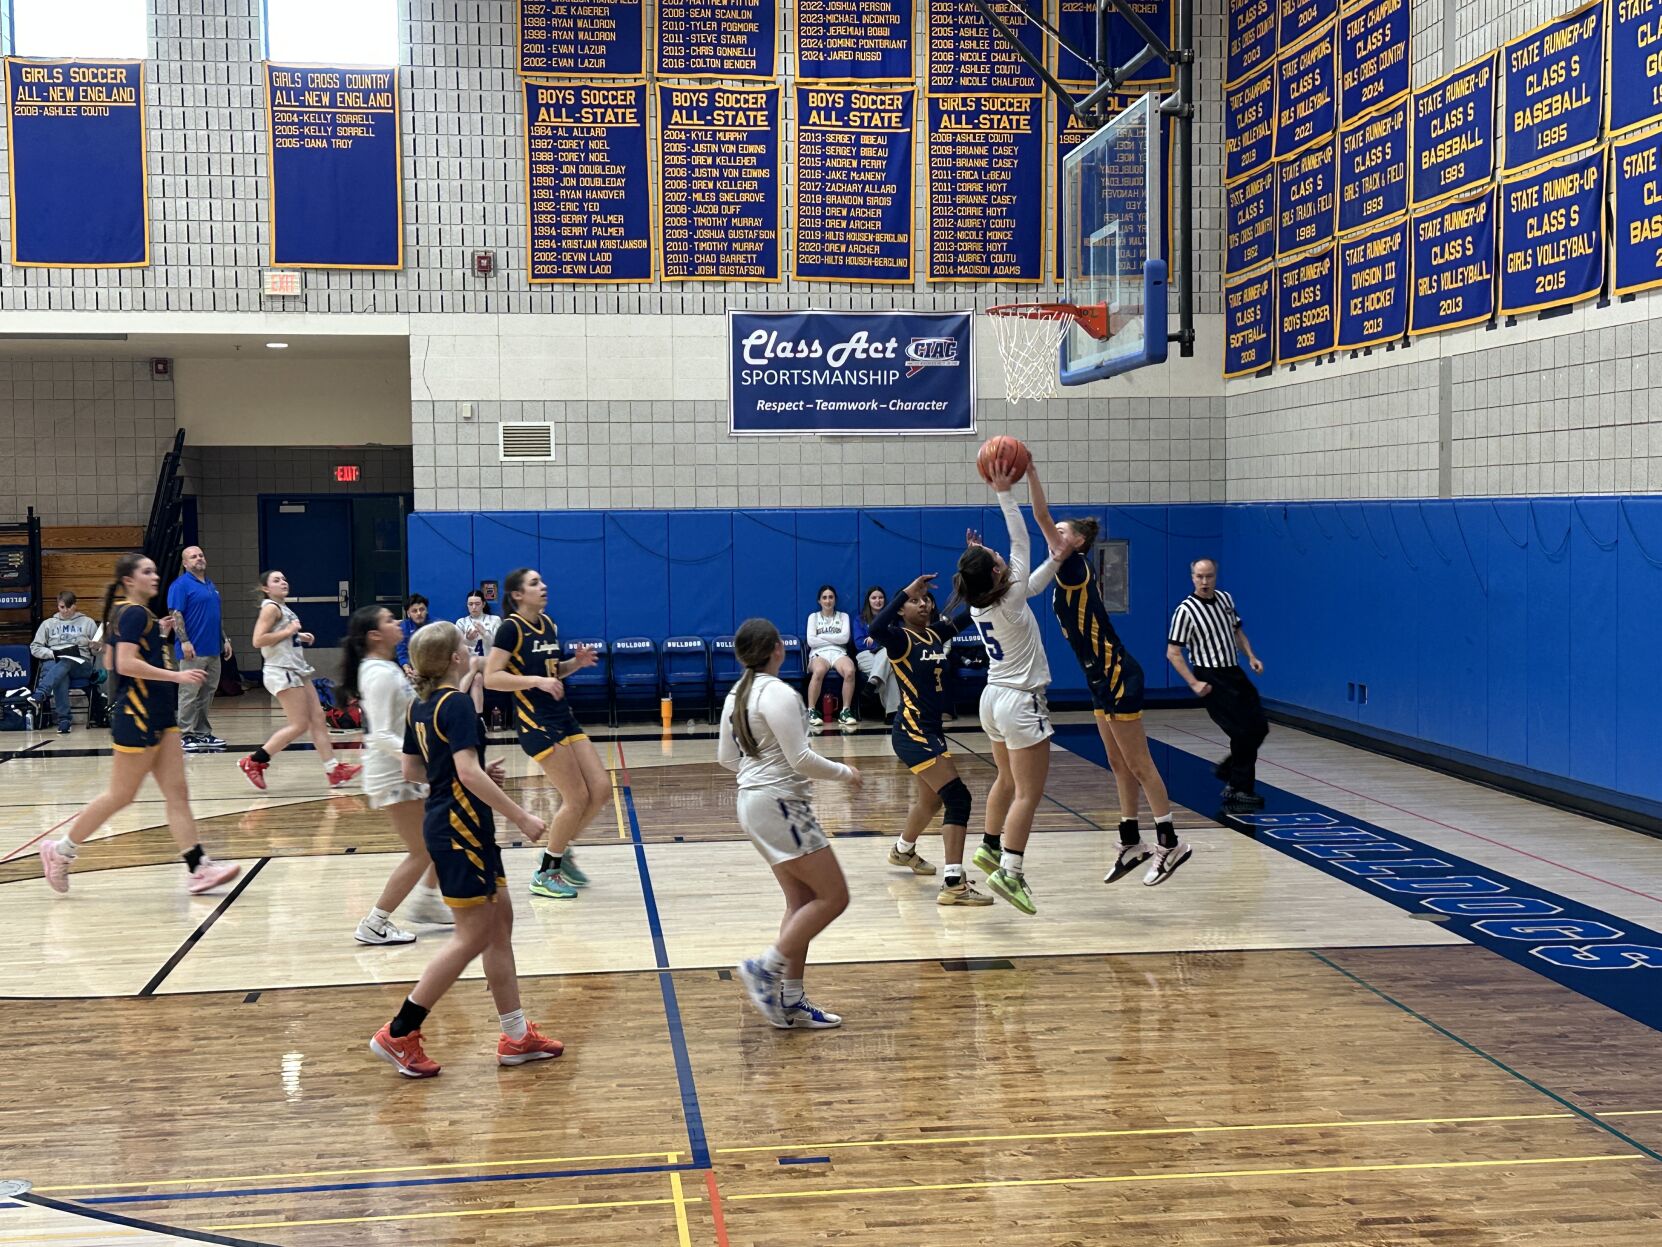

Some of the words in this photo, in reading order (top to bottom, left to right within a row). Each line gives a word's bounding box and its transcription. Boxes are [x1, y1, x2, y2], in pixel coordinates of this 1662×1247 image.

[860, 2, 891, 12] PERSON
[1347, 15, 1366, 40] STATE
[721, 35, 747, 44] STARR
[1356, 28, 1383, 59] CLASS
[1385, 23, 1391, 41] S
[1512, 41, 1540, 72] STATE
[1544, 15, 1596, 57] RUNNER-UP
[578, 45, 606, 54] LAZUR
[856, 52, 881, 60] RUSSO
[579, 59, 605, 68] LAZUR
[995, 65, 1020, 74] COUTU
[22, 68, 63, 82] GIRLS
[70, 68, 126, 83] SOCCER
[273, 72, 301, 87] GIRLS
[308, 74, 339, 88] CROSS
[346, 74, 390, 88] COUNTRY
[992, 77, 1034, 86] CHALIFOUX
[1290, 73, 1312, 99] CLASS
[1315, 69, 1320, 85] S
[1526, 61, 1566, 96] CLASS
[1571, 55, 1580, 77] S
[18, 86, 74, 101] ALL-NEW
[80, 87, 135, 101] ENGLAND
[275, 91, 329, 106] ALL-NEW
[337, 92, 392, 107] ENGLAND
[538, 89, 574, 104] BOYS
[582, 90, 635, 105] SOCCER
[1362, 79, 1384, 102] 2024
[1419, 90, 1442, 117] STATE
[1446, 67, 1489, 104] RUNNER-UP
[673, 92, 708, 106] BOYS
[715, 93, 766, 108] SOCCER
[809, 93, 844, 107] BOYS
[852, 94, 902, 109] SOCCER
[939, 98, 976, 111] GIRLS
[981, 98, 1030, 111] SOCCER
[1515, 83, 1591, 132] BASEBALL
[81, 107, 109, 116] COUTU
[336, 115, 374, 124] SORRELL
[538, 107, 637, 123] ALL-STATE
[671, 110, 768, 125] ALL-STATE
[809, 110, 902, 127] ALL-STATE
[1431, 107, 1463, 138] CLASS
[1468, 102, 1474, 121] S
[941, 114, 1030, 129] ALL-STATE
[337, 127, 374, 136] SORRELL
[573, 128, 606, 136] ALLARD
[717, 132, 747, 140] MURPHY
[1295, 122, 1312, 141] 2021
[1538, 123, 1568, 149] 1995
[332, 140, 352, 148] TROY
[993, 146, 1019, 155] CASEY
[1344, 131, 1363, 154] STATE
[1422, 127, 1483, 170] BASEBALL
[1355, 146, 1382, 173] CLASS
[1386, 142, 1391, 159] S
[1623, 147, 1656, 179] STATE
[1362, 172, 1380, 194] TRACK
[1387, 162, 1403, 184] FIELD
[1441, 163, 1464, 185] 1993
[865, 184, 896, 194] ALLARD
[1511, 186, 1539, 212] STATE
[1543, 167, 1598, 203] RUNNER-UP
[986, 208, 1007, 216] HOYT
[1363, 196, 1383, 216] 1993
[592, 215, 624, 224] PALMER
[1527, 208, 1566, 239] CLASS
[1571, 205, 1579, 227] S
[728, 230, 775, 239] GUSTAFSON
[1420, 218, 1441, 241] STATE
[720, 254, 757, 263] BARRETT
[991, 254, 1016, 263] COUTU
[1346, 245, 1364, 266] STATE
[1432, 239, 1462, 265] CLASS
[1466, 236, 1473, 255] S
[1507, 249, 1532, 273] GIRLS
[271, 274, 295, 292] EXIT
[1352, 266, 1381, 290] DIVISION
[1385, 262, 1395, 280] III
[1418, 275, 1437, 296] GIRLS
[1441, 260, 1490, 291] VOLLEYBALL
[1536, 270, 1566, 293] 2015
[1292, 287, 1313, 308] CLASS
[1316, 284, 1320, 300] S
[1350, 297, 1362, 316] ICE
[1365, 287, 1395, 312] HOCKEY
[1440, 297, 1462, 316] 2013
[1236, 307, 1254, 326] CLASS
[1256, 305, 1261, 319] S
[1284, 314, 1300, 332] BOYS
[1302, 305, 1330, 327] SOCCER
[1364, 318, 1382, 335] 2013
[1230, 324, 1266, 348] SOFTBALL
[742, 329, 822, 365] Class
[827, 331, 898, 368] Act
[914, 342, 958, 359] CIAC
[742, 370, 899, 386] SPORTSMANSHIP
[757, 400, 804, 413] Respect
[816, 400, 877, 411] Teamwork
[889, 400, 948, 411] Character
[338, 466, 357, 481] EXIT
[474, 639, 484, 656] 4
[979, 622, 1004, 660] 5
